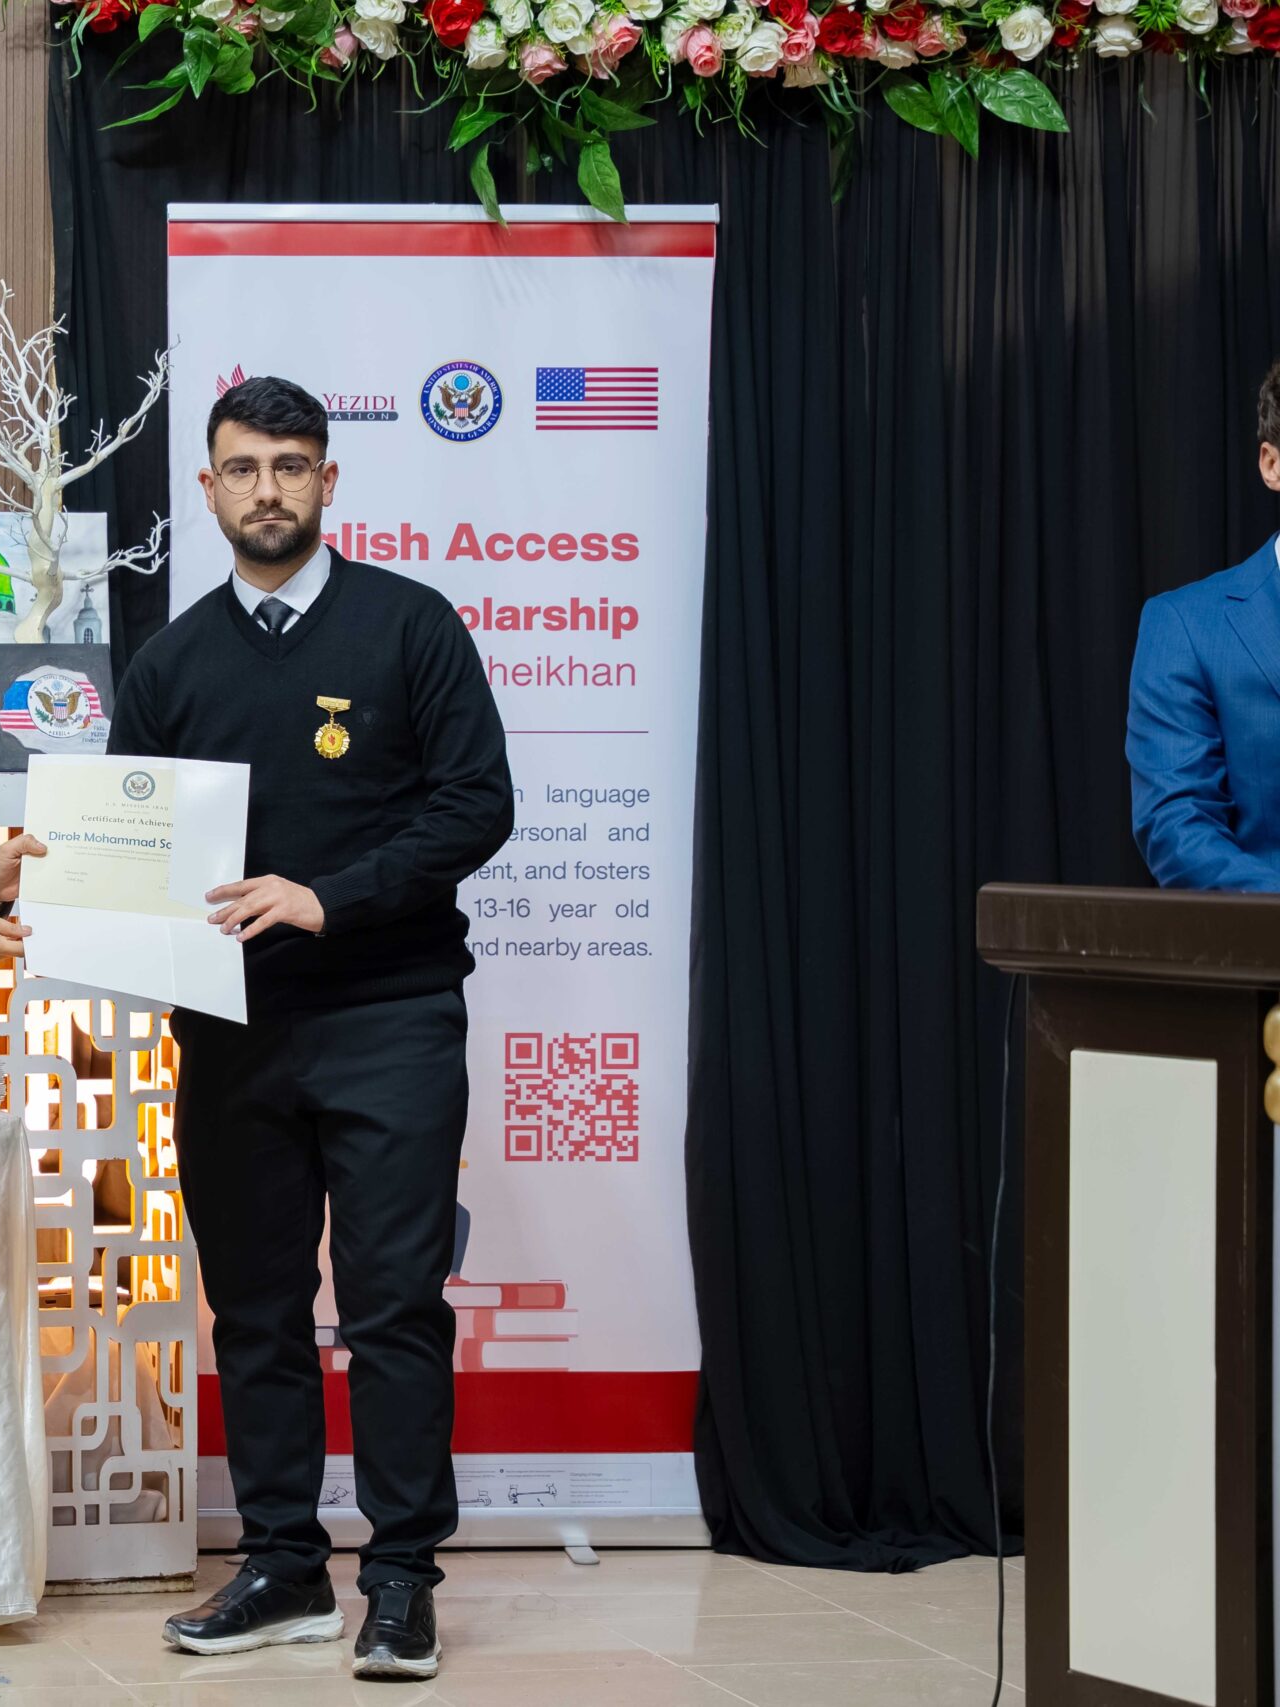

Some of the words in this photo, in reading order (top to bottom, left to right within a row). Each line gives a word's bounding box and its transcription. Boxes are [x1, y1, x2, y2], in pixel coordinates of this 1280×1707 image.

[423, 368, 443, 394] UNITED
[480, 369, 500, 400] AMERICA
[322, 393, 396, 411] YEZIDI
[327, 412, 389, 421] ATION
[424, 411, 467, 440] CONSULATE
[467, 411, 499, 439] GENERAL
[445, 522, 640, 562] Access
[481, 655, 636, 687] heikhan
[546, 784, 650, 808] language
[81, 814, 125, 824] Certificate
[127, 815, 136, 825] of
[84, 832, 157, 849] Mohammad
[607, 822, 649, 842] and
[524, 861, 566, 880] and
[573, 861, 650, 880] fosters
[473, 898, 531, 918] 13-16
[549, 901, 597, 923] year
[615, 899, 649, 918] old
[465, 937, 499, 956] nd
[505, 937, 581, 961] nearby
[587, 941, 653, 956] areas.
